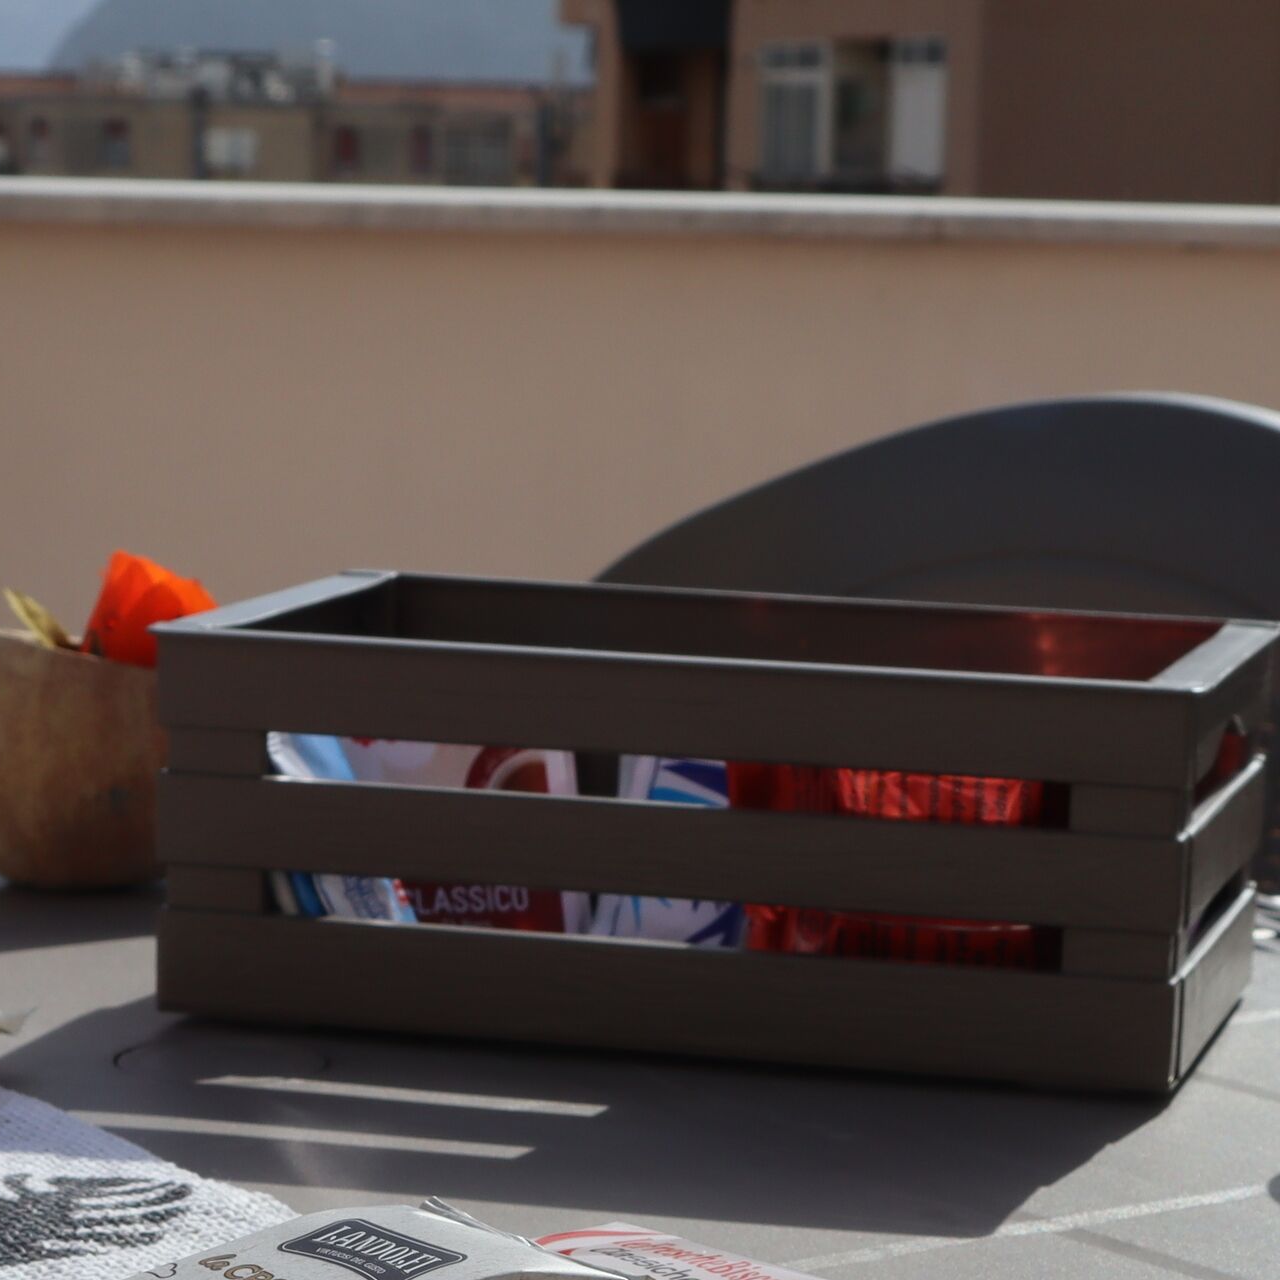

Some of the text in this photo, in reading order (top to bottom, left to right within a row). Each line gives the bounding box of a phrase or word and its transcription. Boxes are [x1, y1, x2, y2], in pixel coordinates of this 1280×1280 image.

[406, 884, 529, 915] LASSICO
[199, 1253, 238, 1271] la
[312, 1226, 442, 1274] LANDOLFI
